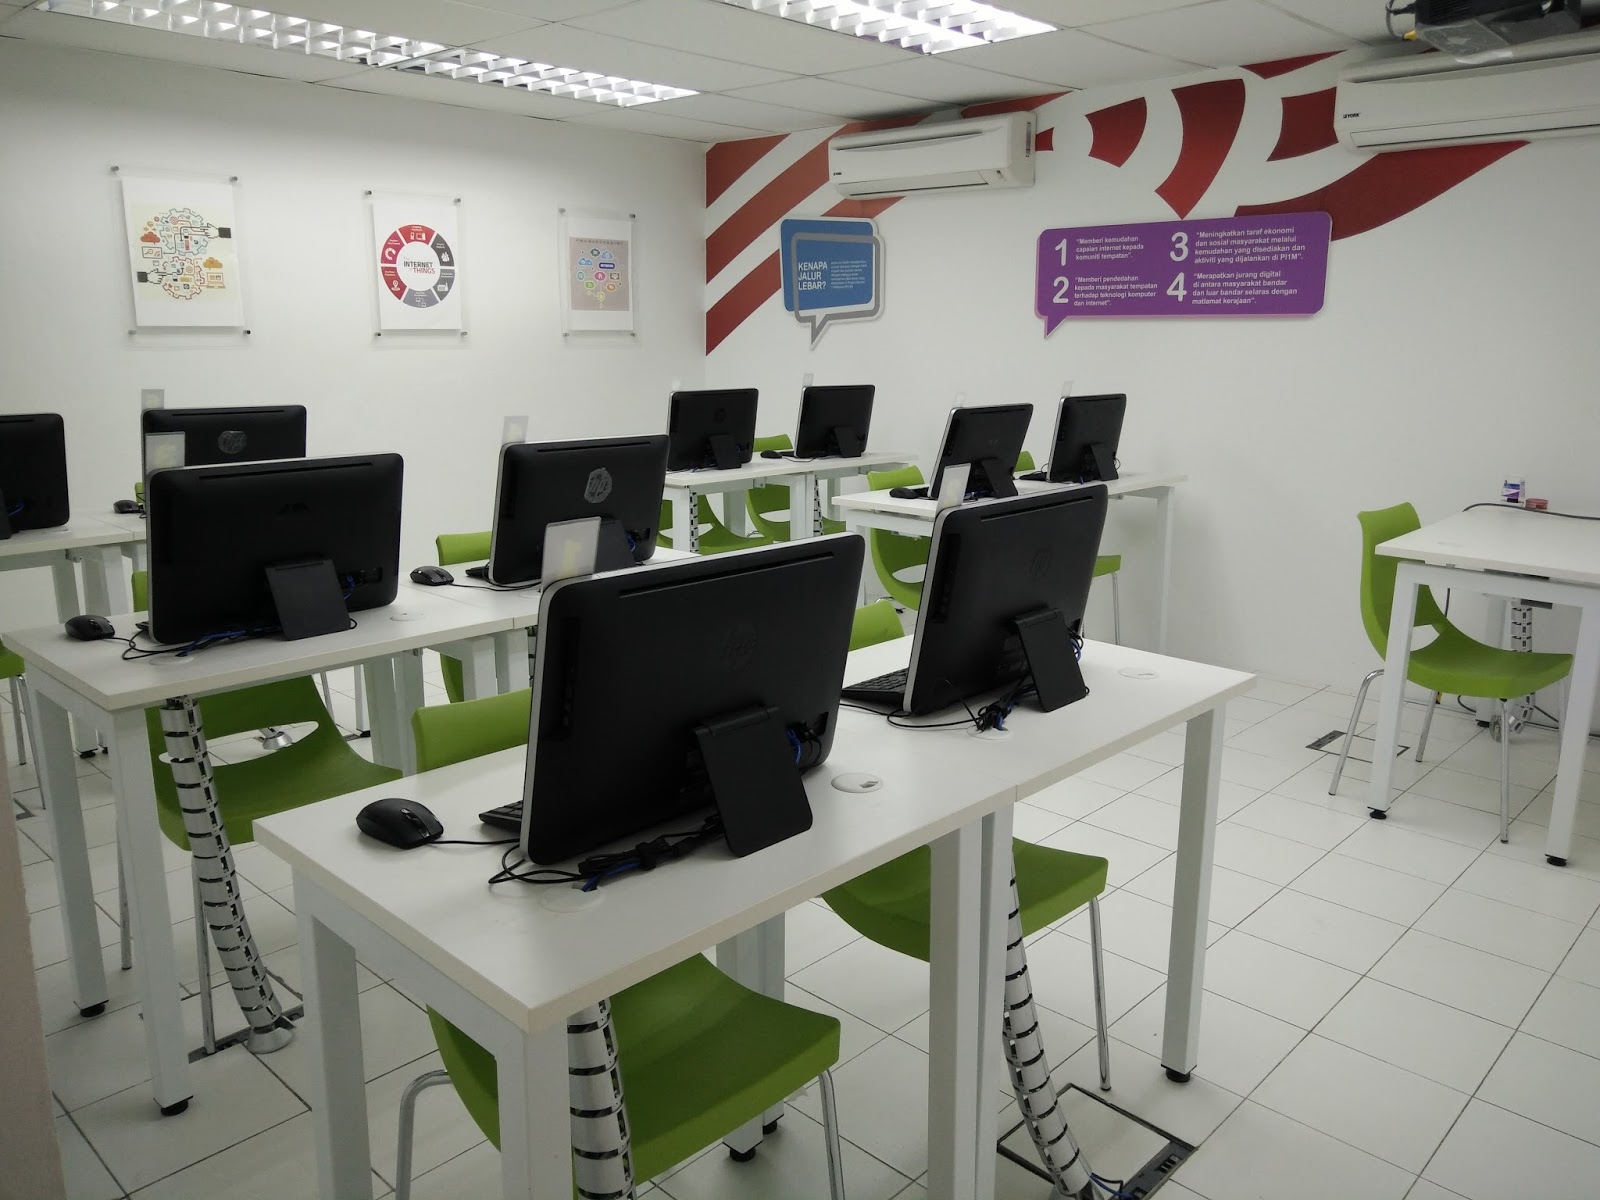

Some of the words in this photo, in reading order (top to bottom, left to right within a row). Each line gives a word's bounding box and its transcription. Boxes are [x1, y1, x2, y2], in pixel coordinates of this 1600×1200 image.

[1055, 238, 1067, 266] 1
[1170, 232, 1189, 262] 3
[798, 261, 828, 271] KENAPA
[798, 271, 821, 280] JALUR
[798, 281, 827, 290] LEBAR?
[1166, 272, 1187, 302] 4
[1222, 280, 1261, 288] masyarakat
[1053, 276, 1069, 303] 2
[1271, 287, 1298, 296] dengan
